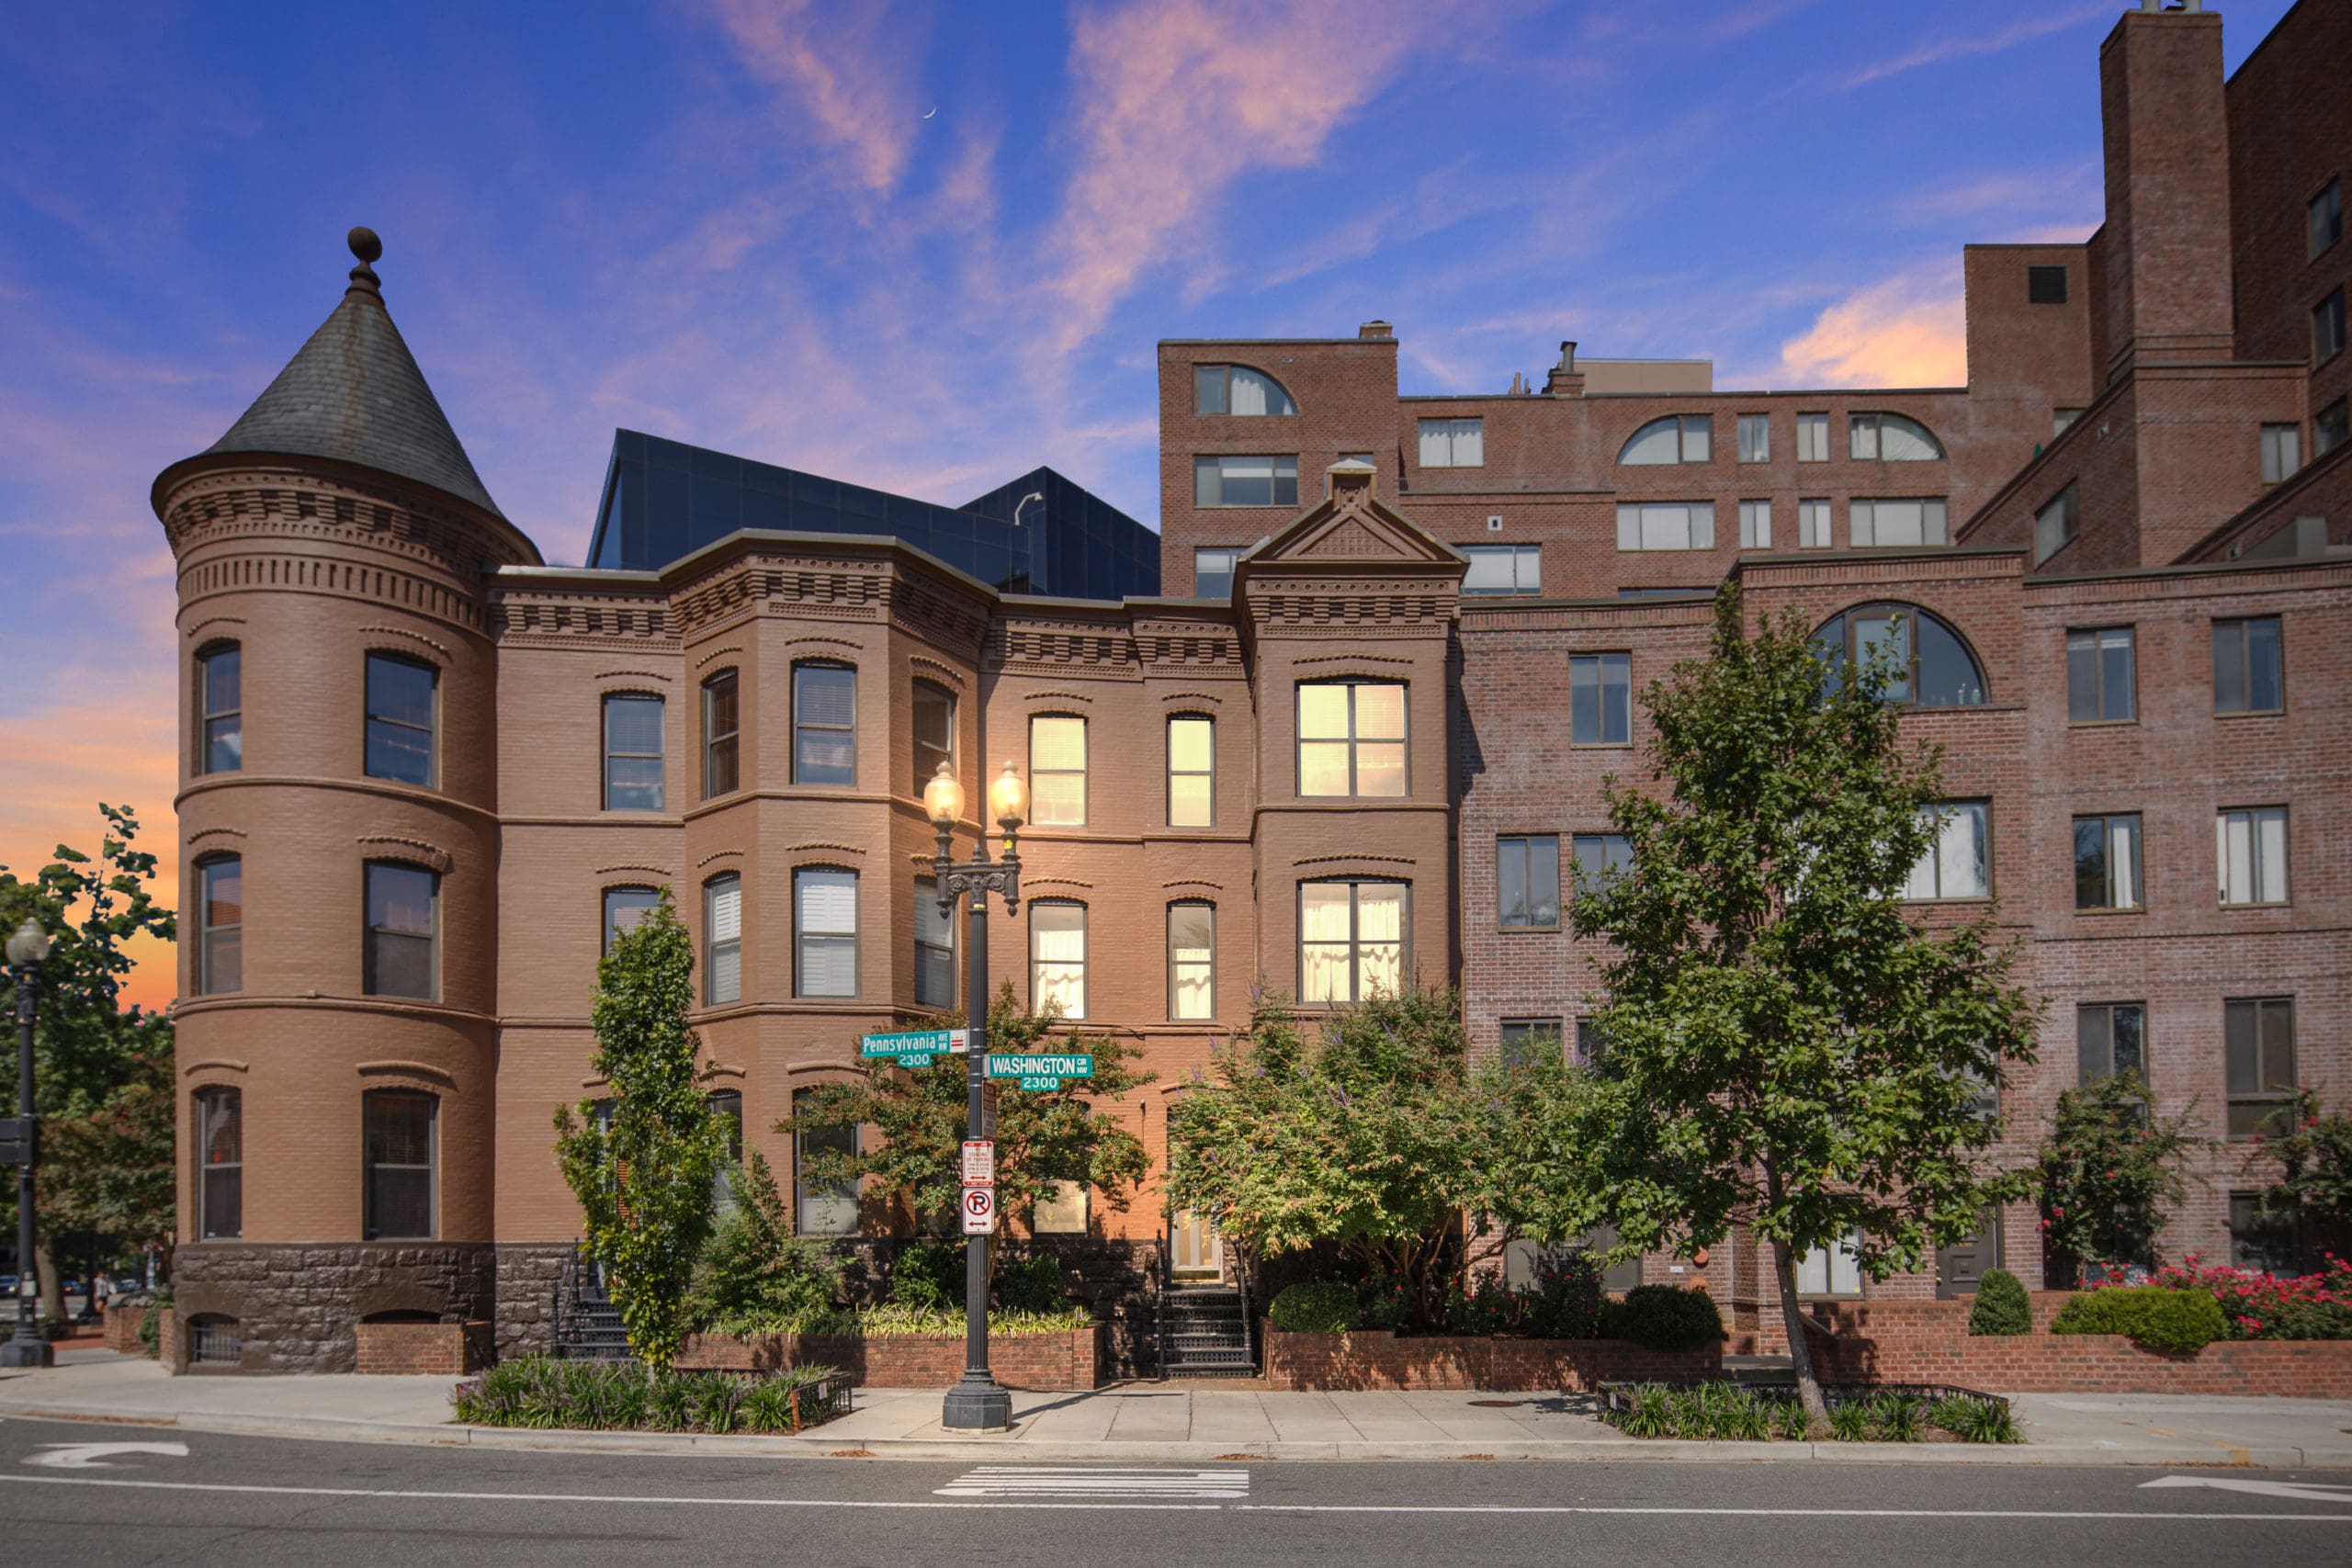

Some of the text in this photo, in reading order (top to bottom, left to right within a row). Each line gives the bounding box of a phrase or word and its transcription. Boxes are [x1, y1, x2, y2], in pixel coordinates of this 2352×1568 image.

[864, 1033, 936, 1054] Pennsylvania
[938, 1032, 948, 1043] AVE
[938, 1043, 948, 1052] NW
[899, 1053, 930, 1066] 2300
[992, 1057, 1075, 1074] WASHINGTON
[1023, 1077, 1057, 1089] 2300
[974, 1195, 986, 1211] P
